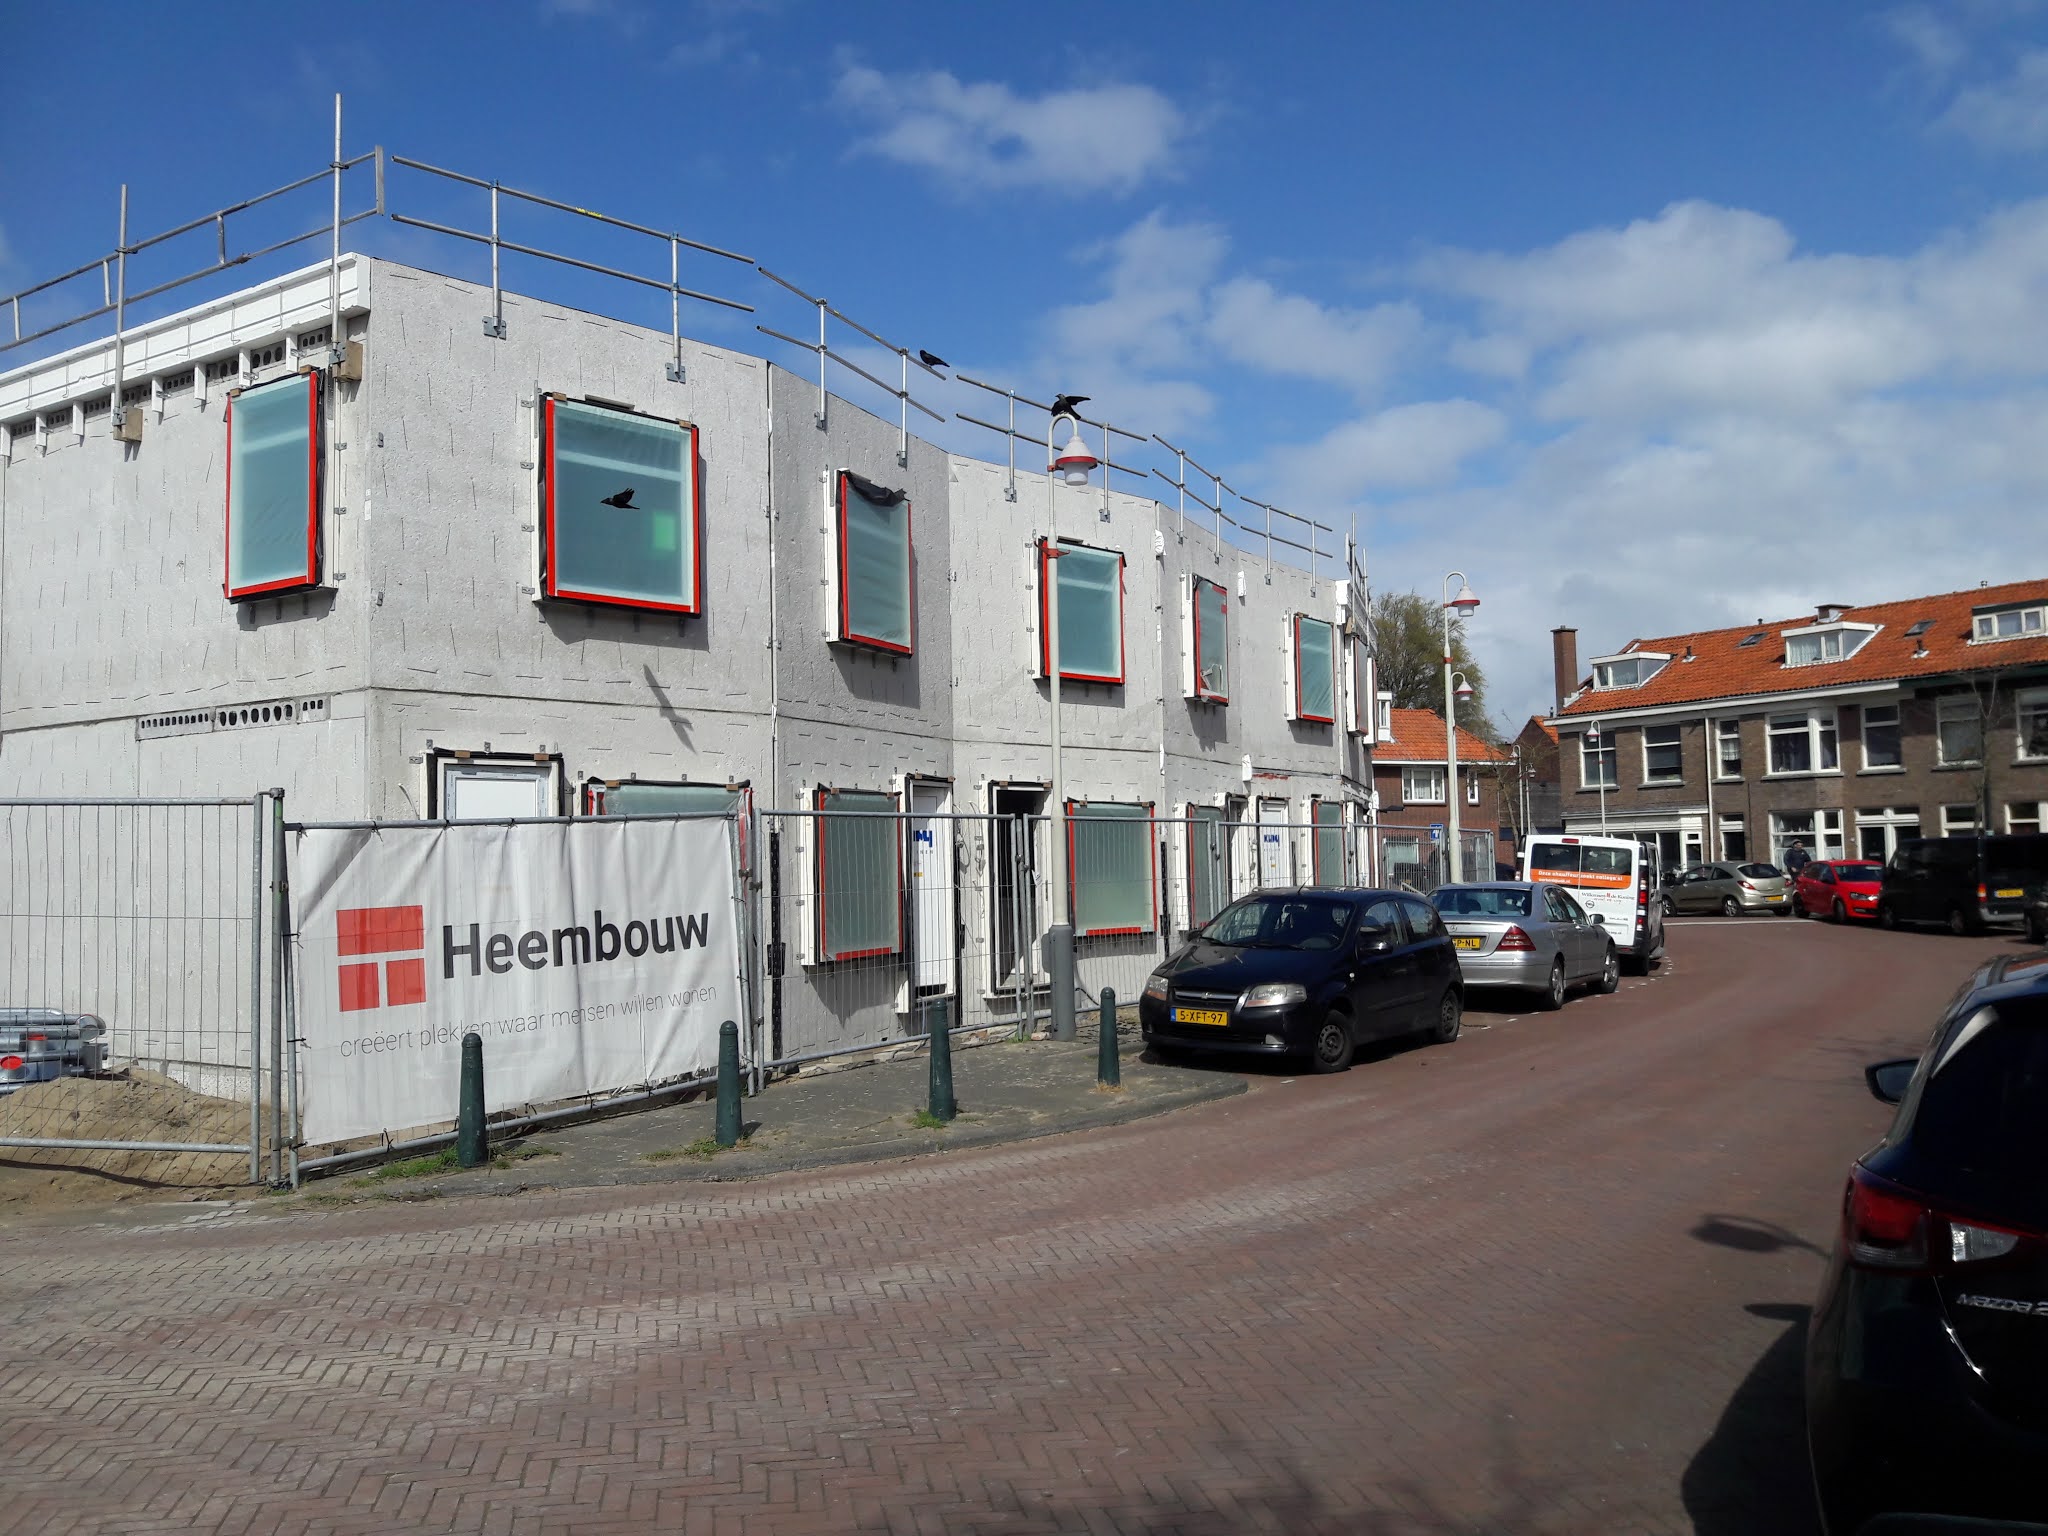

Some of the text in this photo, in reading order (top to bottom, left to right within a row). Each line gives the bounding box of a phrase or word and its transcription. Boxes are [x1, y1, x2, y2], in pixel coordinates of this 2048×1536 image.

[443, 910, 708, 979] Heembouw
[340, 986, 717, 1057] creëert plekken waar mensen willen wonen
[1180, 1010, 1223, 1023] 5-XFT-97
